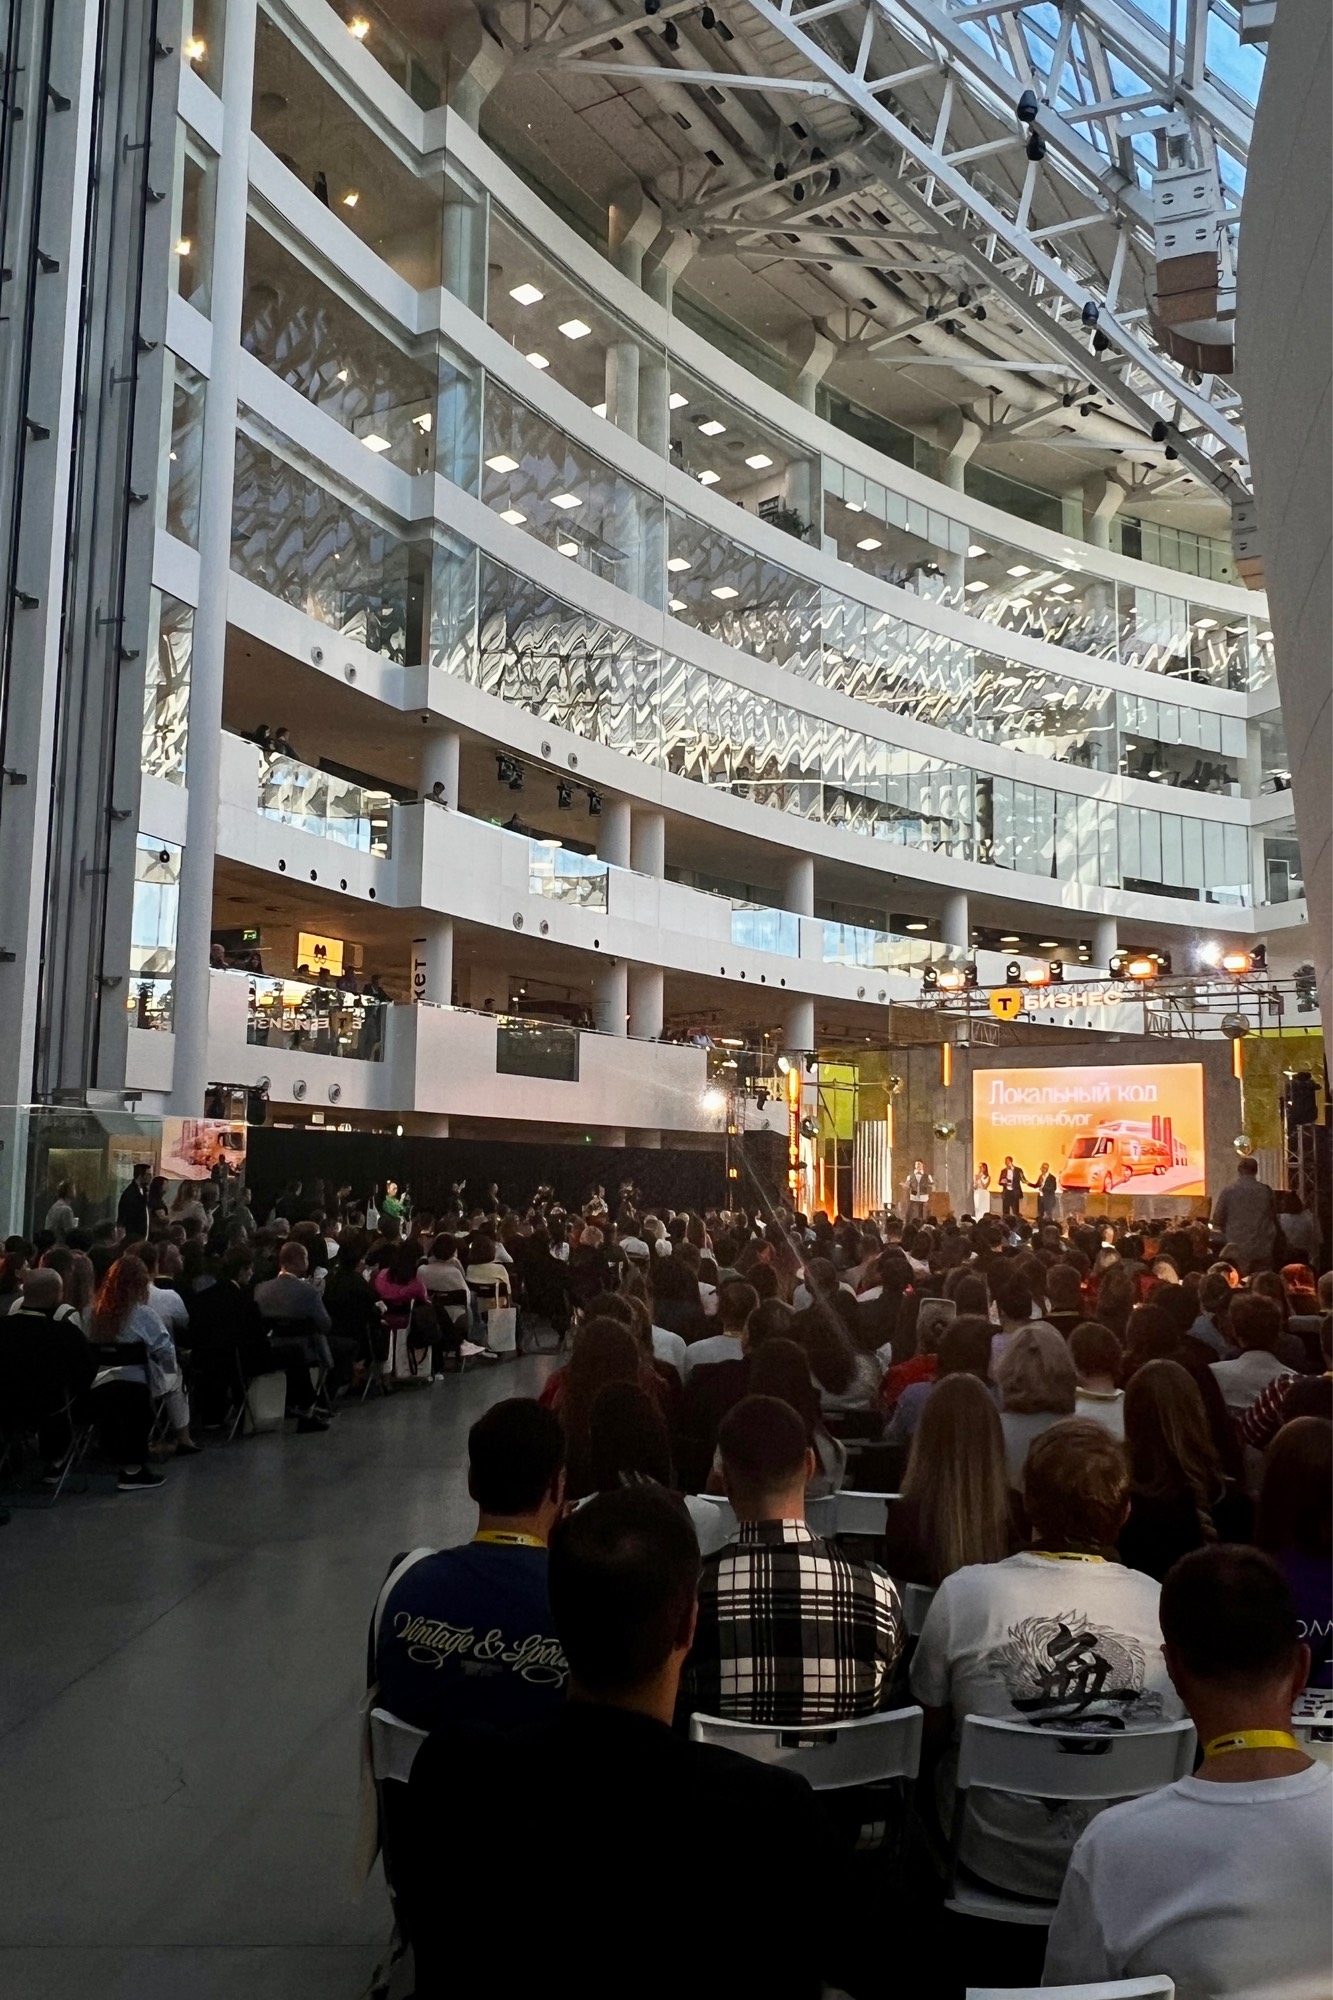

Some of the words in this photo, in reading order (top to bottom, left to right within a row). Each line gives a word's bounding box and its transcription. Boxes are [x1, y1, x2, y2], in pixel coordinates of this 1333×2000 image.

[1024, 990, 1121, 1011] БИЗНЕС
[989, 1080, 1111, 1105] Локальный
[1117, 1084, 1158, 1103] код
[991, 1111, 1093, 1127] Екатеринбург
[394, 1611, 475, 1670] Vintage
[473, 1629, 505, 1659] &
